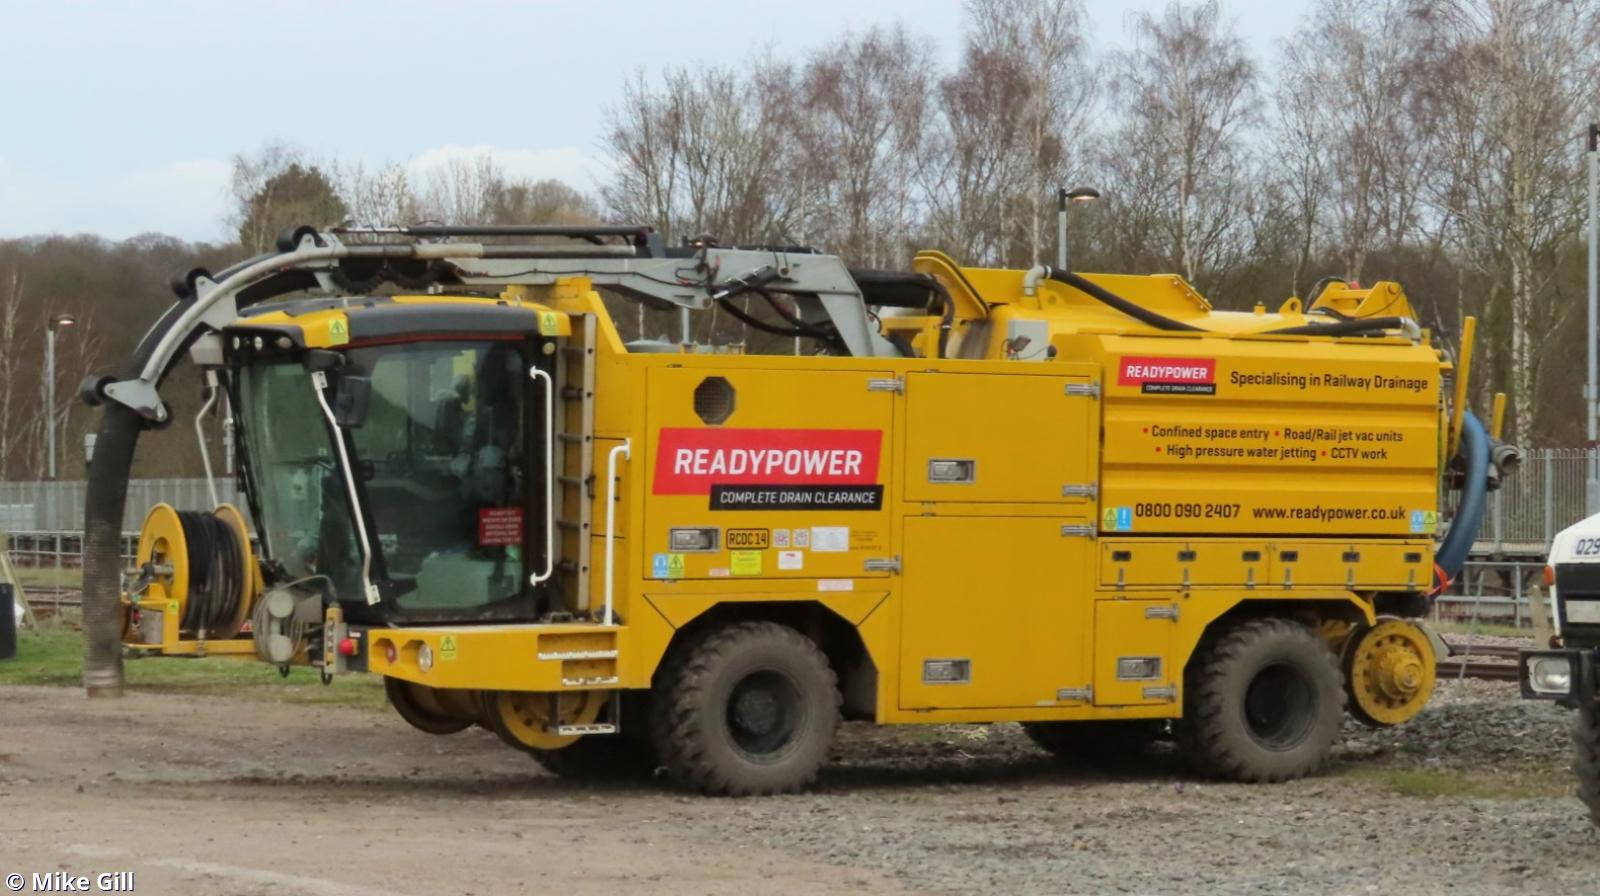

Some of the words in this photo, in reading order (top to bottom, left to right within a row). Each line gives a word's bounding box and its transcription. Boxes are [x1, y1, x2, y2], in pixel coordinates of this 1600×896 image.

[1126, 365, 1208, 379] READYPOWER
[1230, 371, 1306, 389] Specialising
[1309, 373, 1321, 386] in
[1324, 374, 1371, 391] Railway
[1374, 375, 1429, 392] Drainage
[1151, 425, 1202, 438] Confined
[1205, 428, 1237, 440] space
[1240, 428, 1270, 442] entry
[1284, 428, 1336, 442] Road/Rail
[1337, 430, 1353, 443] jet
[1355, 432, 1374, 441] vac
[1376, 430, 1404, 442] units
[1167, 444, 1193, 459] High
[1196, 447, 1245, 459] pressure
[1247, 447, 1278, 458] water
[1280, 446, 1317, 461] jetting
[1331, 447, 1359, 459] CCTV
[1361, 448, 1388, 460] work
[673, 448, 863, 476] READYPOWER
[720, 491, 776, 504] COMPLETE
[779, 491, 812, 504] DRAIN
[814, 491, 876, 504] CLEARANCE
[1135, 503, 1171, 518] 0800
[1174, 503, 1202, 518] 090
[1205, 503, 1241, 519] 2407
[1252, 505, 1406, 522] www.readypower.co.uk
[729, 533, 753, 546] RCDC
[755, 533, 768, 546] 14
